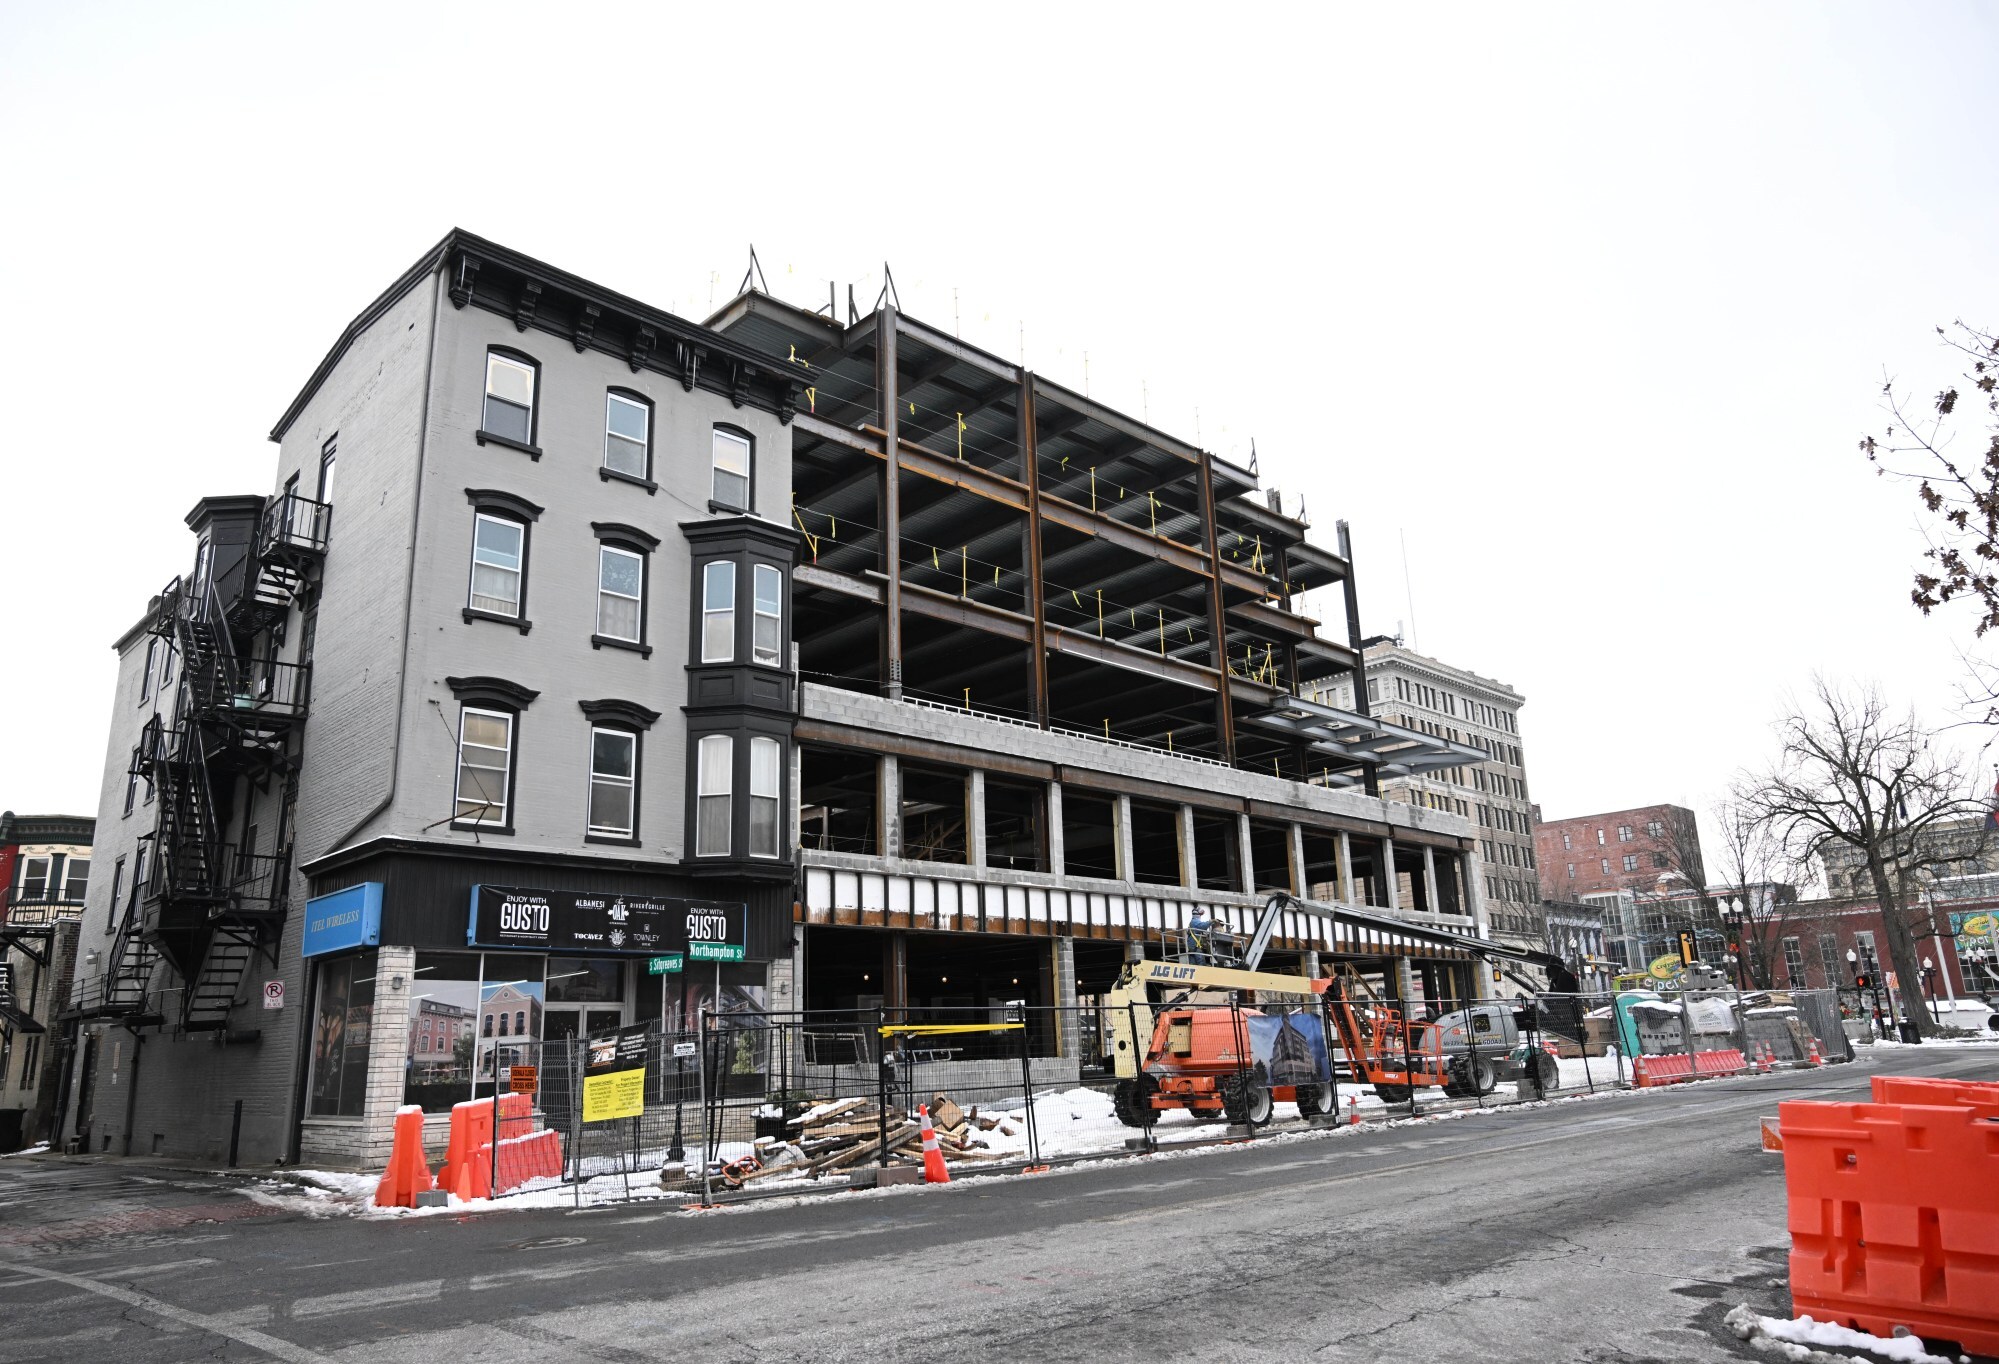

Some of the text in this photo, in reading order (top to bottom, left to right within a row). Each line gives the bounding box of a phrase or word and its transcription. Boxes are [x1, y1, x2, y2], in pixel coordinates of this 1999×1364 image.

[506, 895, 547, 904] ENJOY WITH
[575, 899, 605, 908] ALBANESI
[326, 909, 360, 928] WIRELESS
[500, 903, 550, 931] GUSTO
[612, 904, 626, 921] OAK
[686, 914, 727, 940] GUSTO
[633, 933, 660, 942] TOWNLEY
[690, 944, 743, 959] Northampton St
[653, 957, 678, 972] Sitgreaves
[1150, 965, 1195, 979] JLG LIFT
